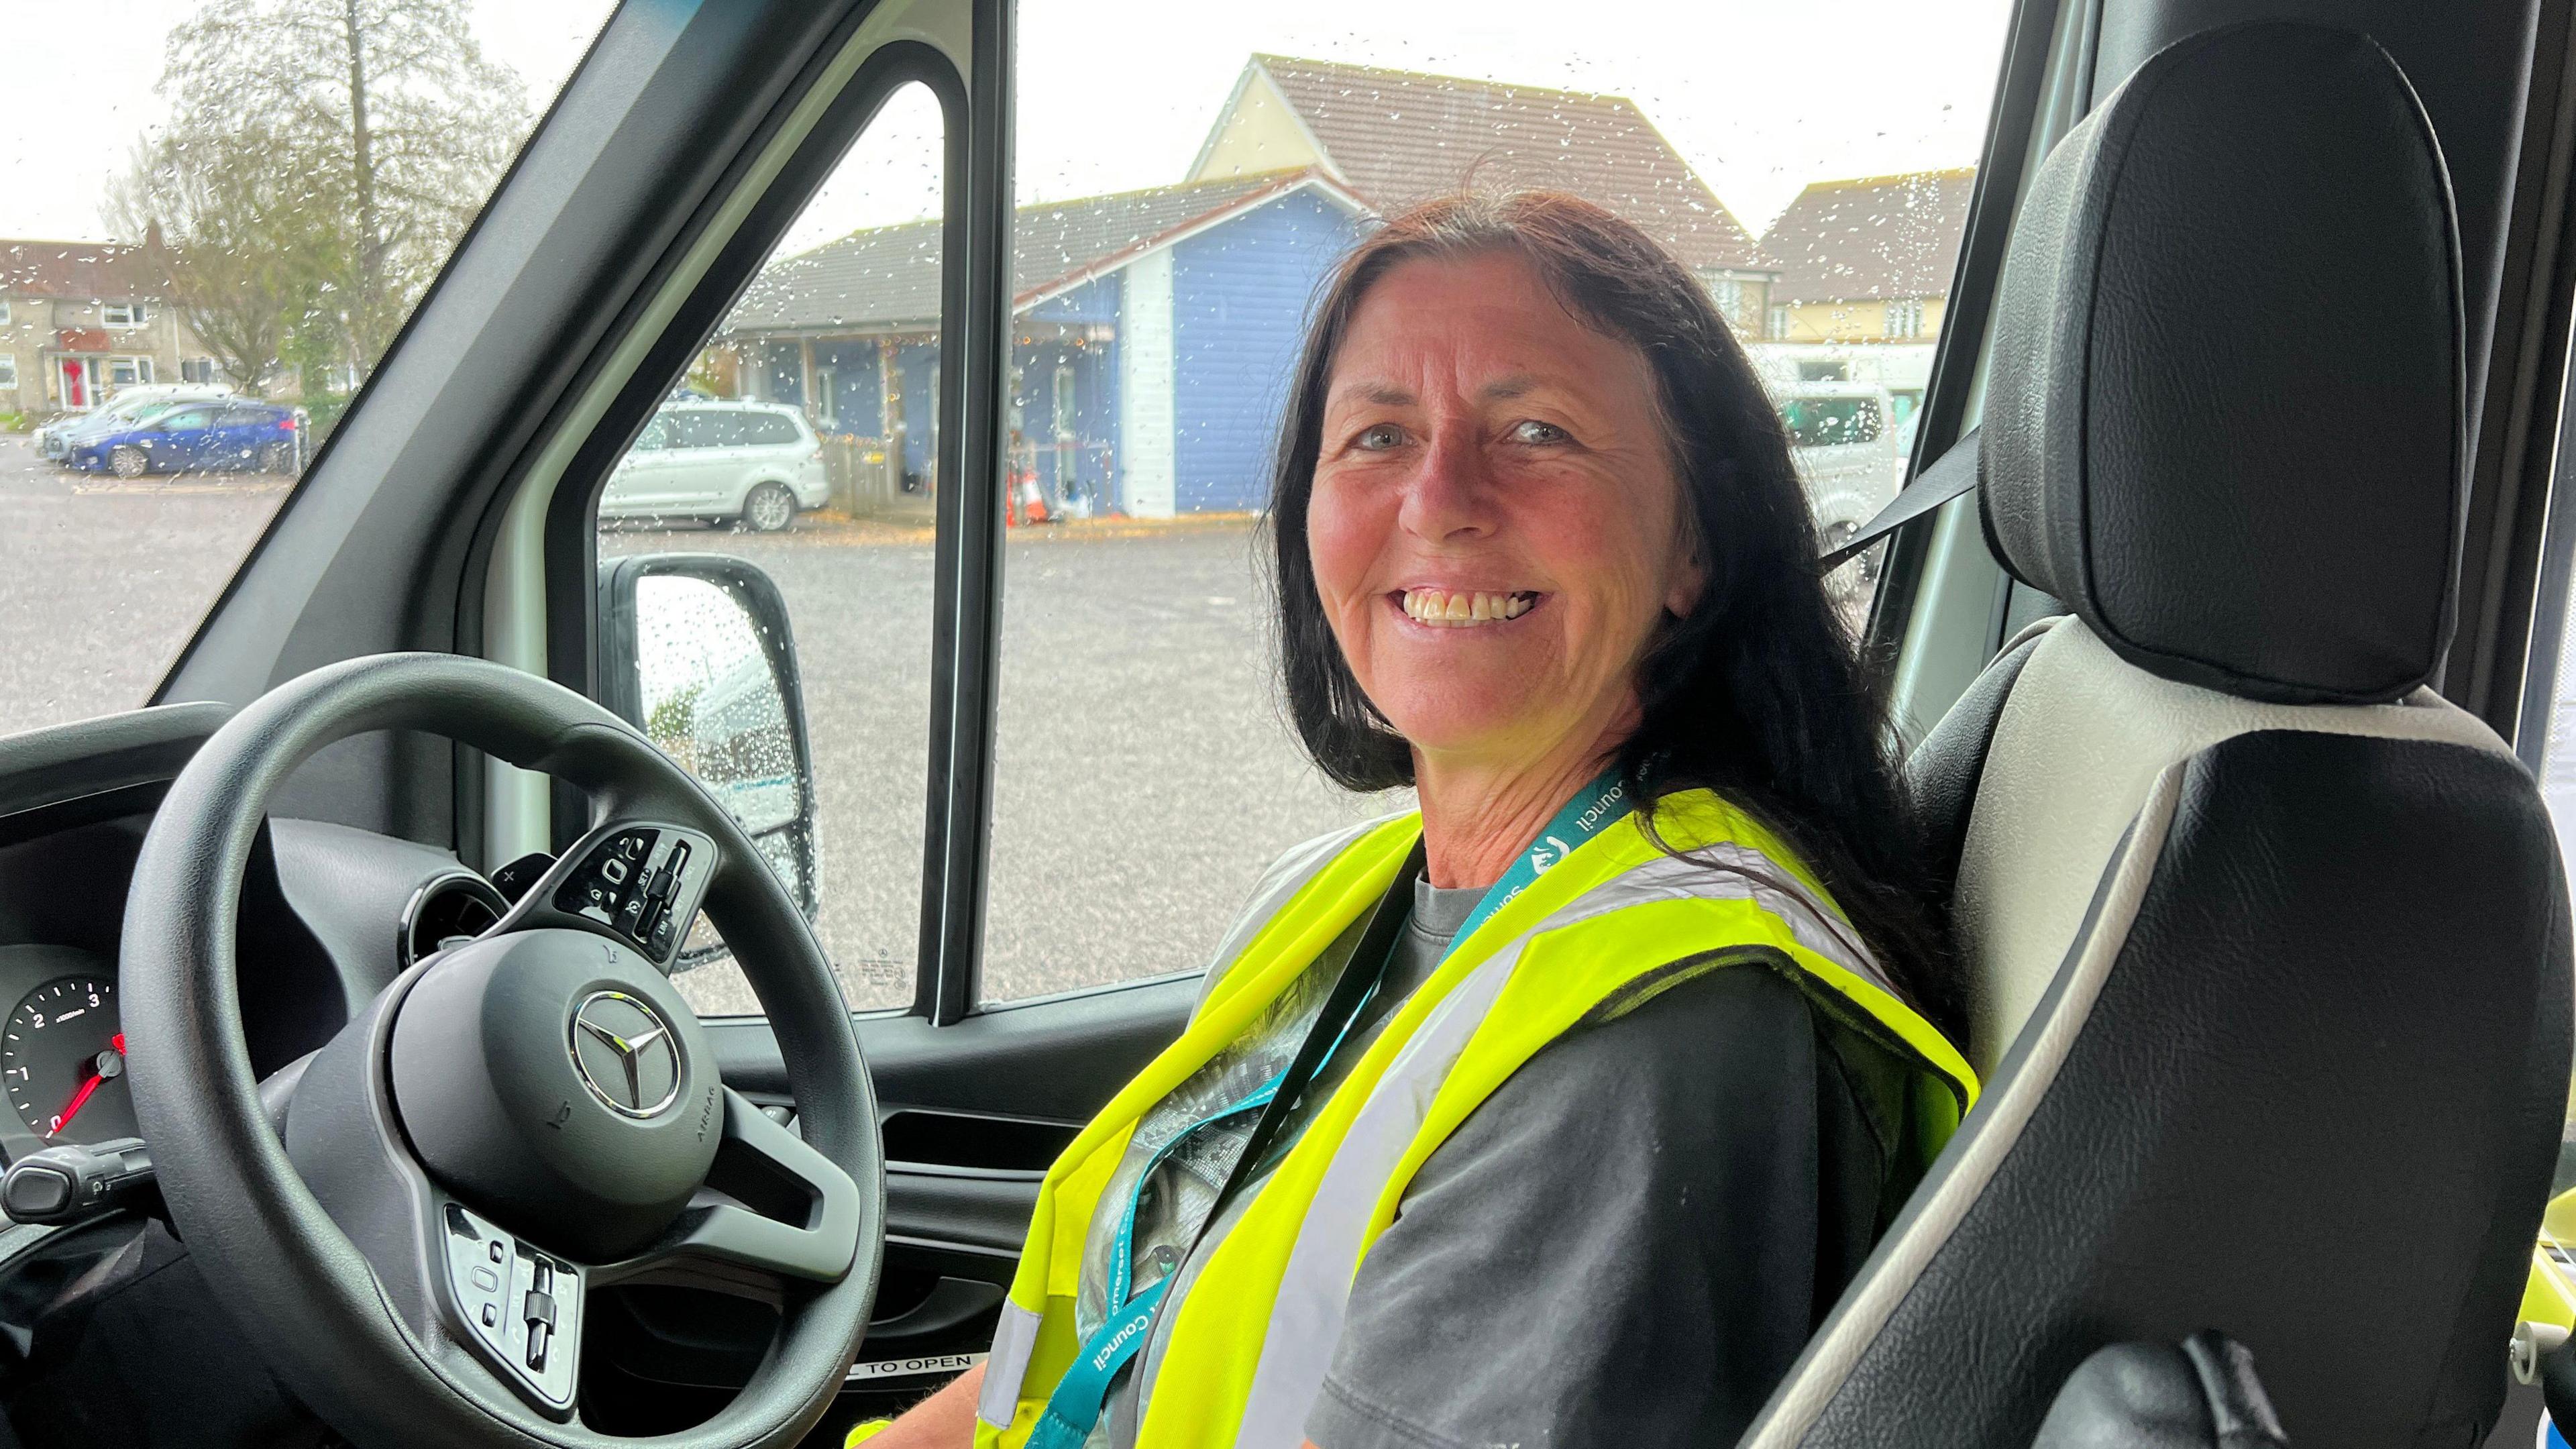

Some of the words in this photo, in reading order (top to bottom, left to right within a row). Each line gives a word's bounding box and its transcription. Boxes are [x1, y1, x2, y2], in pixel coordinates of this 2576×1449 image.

[89, 994, 100, 1008] 3
[34, 1014, 45, 1028] 2
[19, 1067, 29, 1080] 1
[698, 1086, 714, 1142] AIRBAG
[1093, 1315, 1148, 1371] Council
[866, 1362, 898, 1374] TO
[906, 1356, 971, 1371] OPEN
